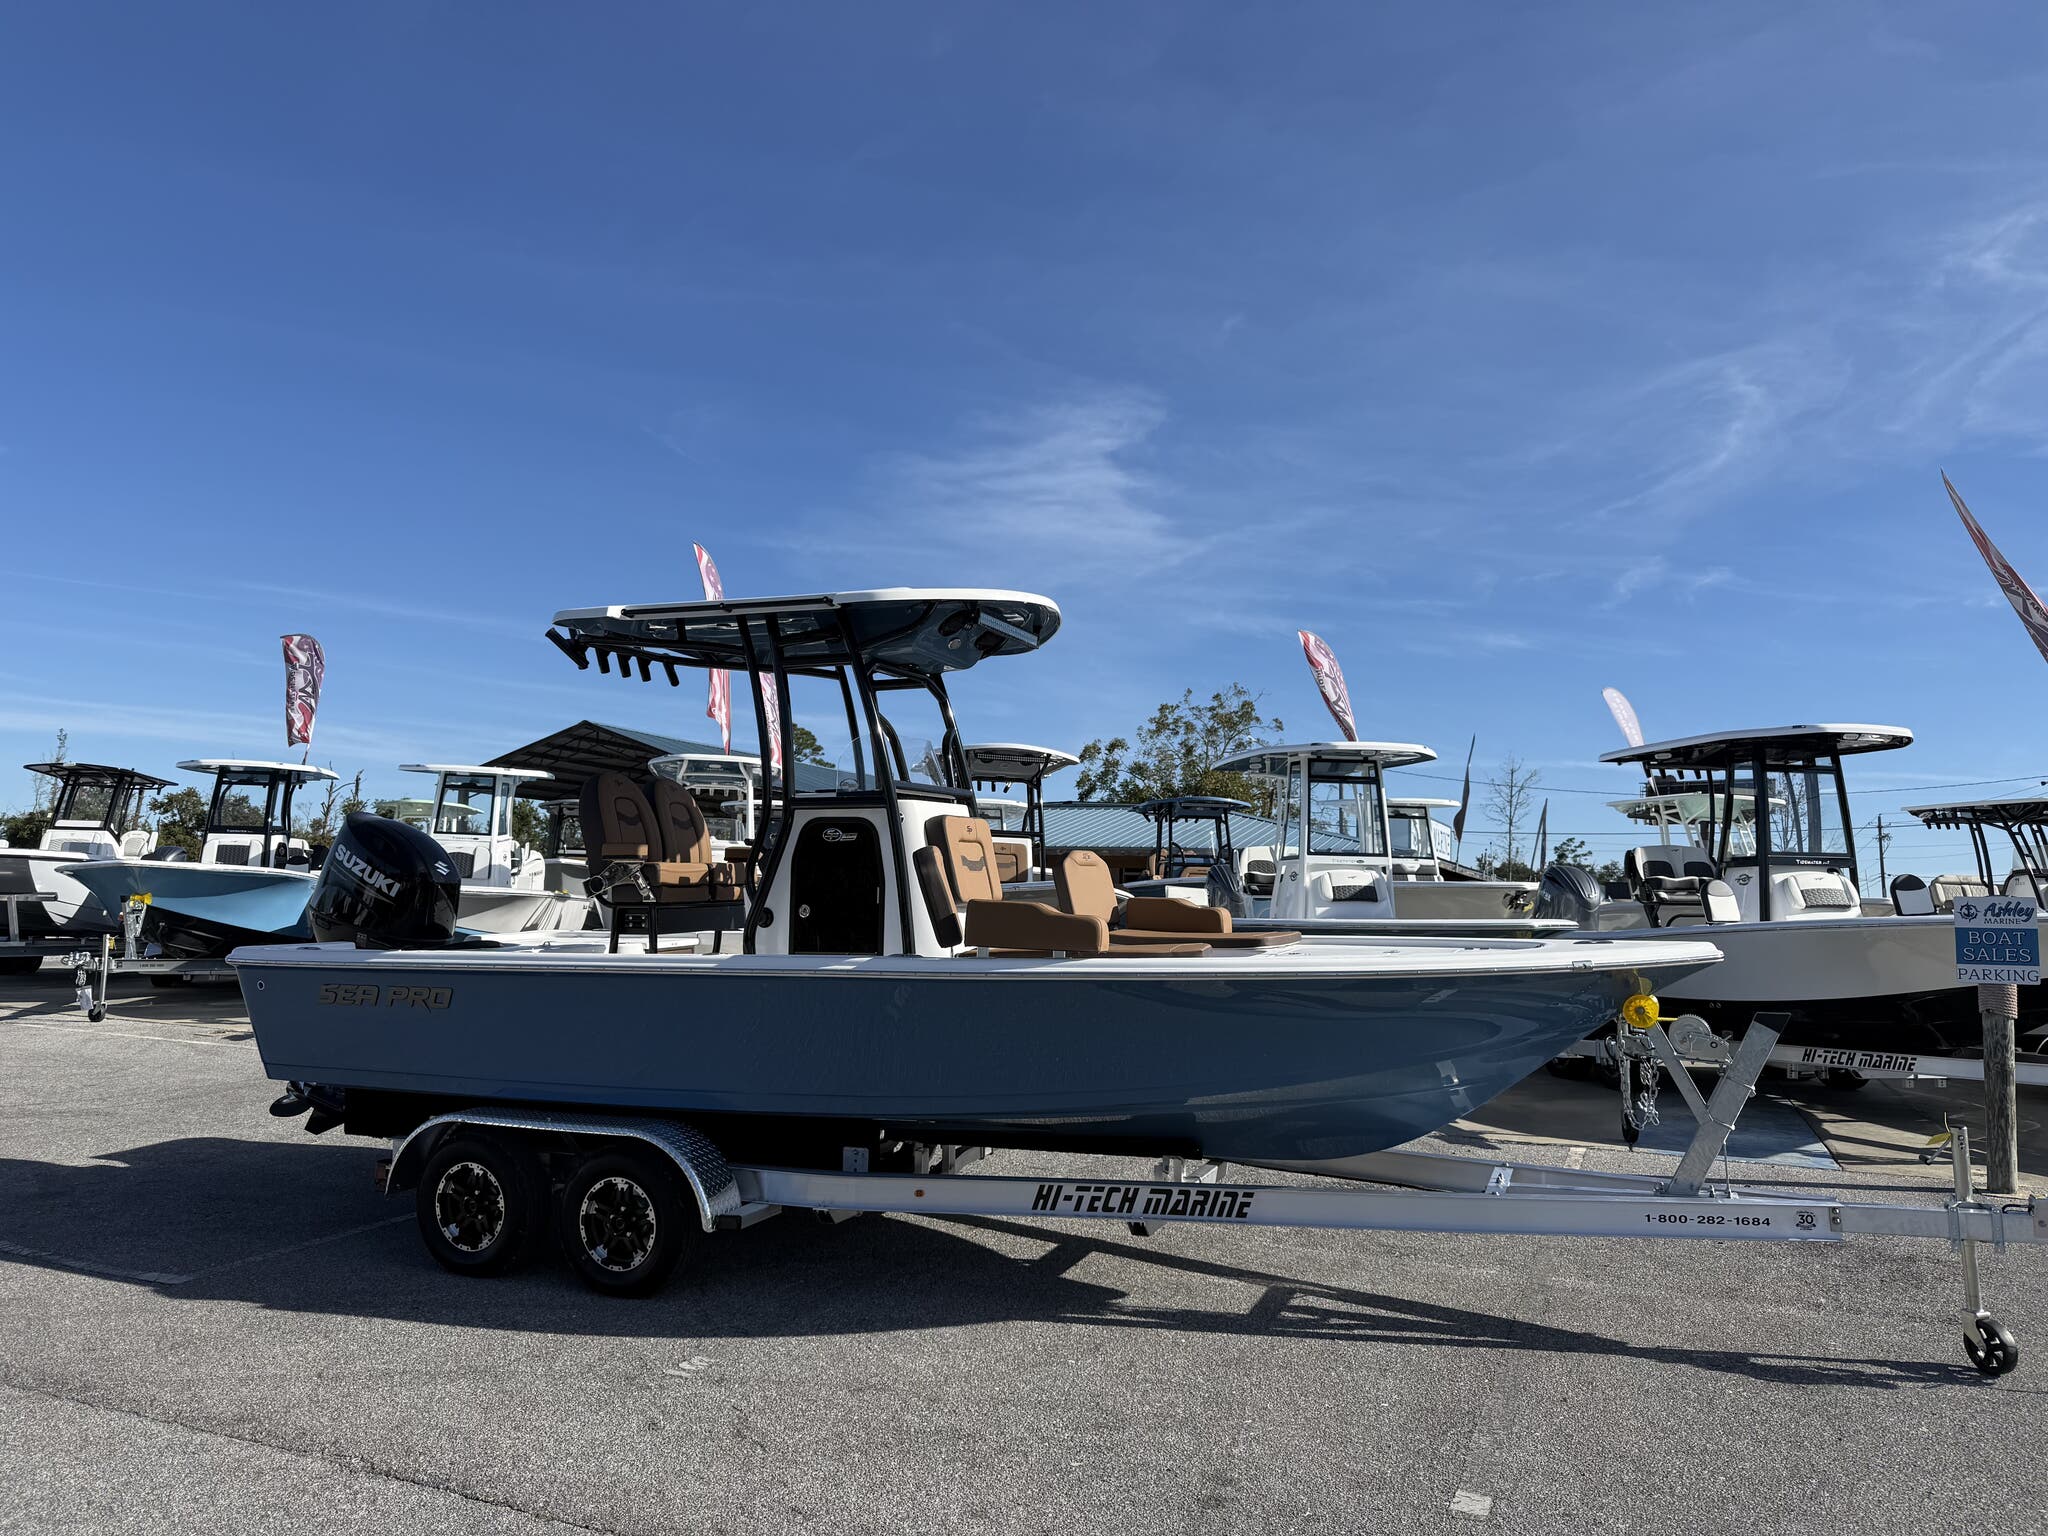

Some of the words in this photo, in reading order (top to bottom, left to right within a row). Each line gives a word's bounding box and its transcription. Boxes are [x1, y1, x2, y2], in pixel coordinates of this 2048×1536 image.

[335, 844, 401, 897] SUZUKI
[1984, 901, 2035, 923] Ashley
[1968, 931, 2026, 946] BOAT
[1963, 947, 2032, 962] SALES
[1957, 968, 2040, 983] PARKING
[319, 984, 380, 1007] SEA
[386, 986, 454, 1013] PRO
[1801, 1047, 1857, 1067] HI-TECH
[1858, 1053, 1918, 1072] MARINE
[1031, 1184, 1140, 1214] HI-TECH
[1142, 1188, 1255, 1219] MARINE
[1645, 1213, 1771, 1227] 1-800-282-1684
[1798, 1214, 1814, 1225] 30
